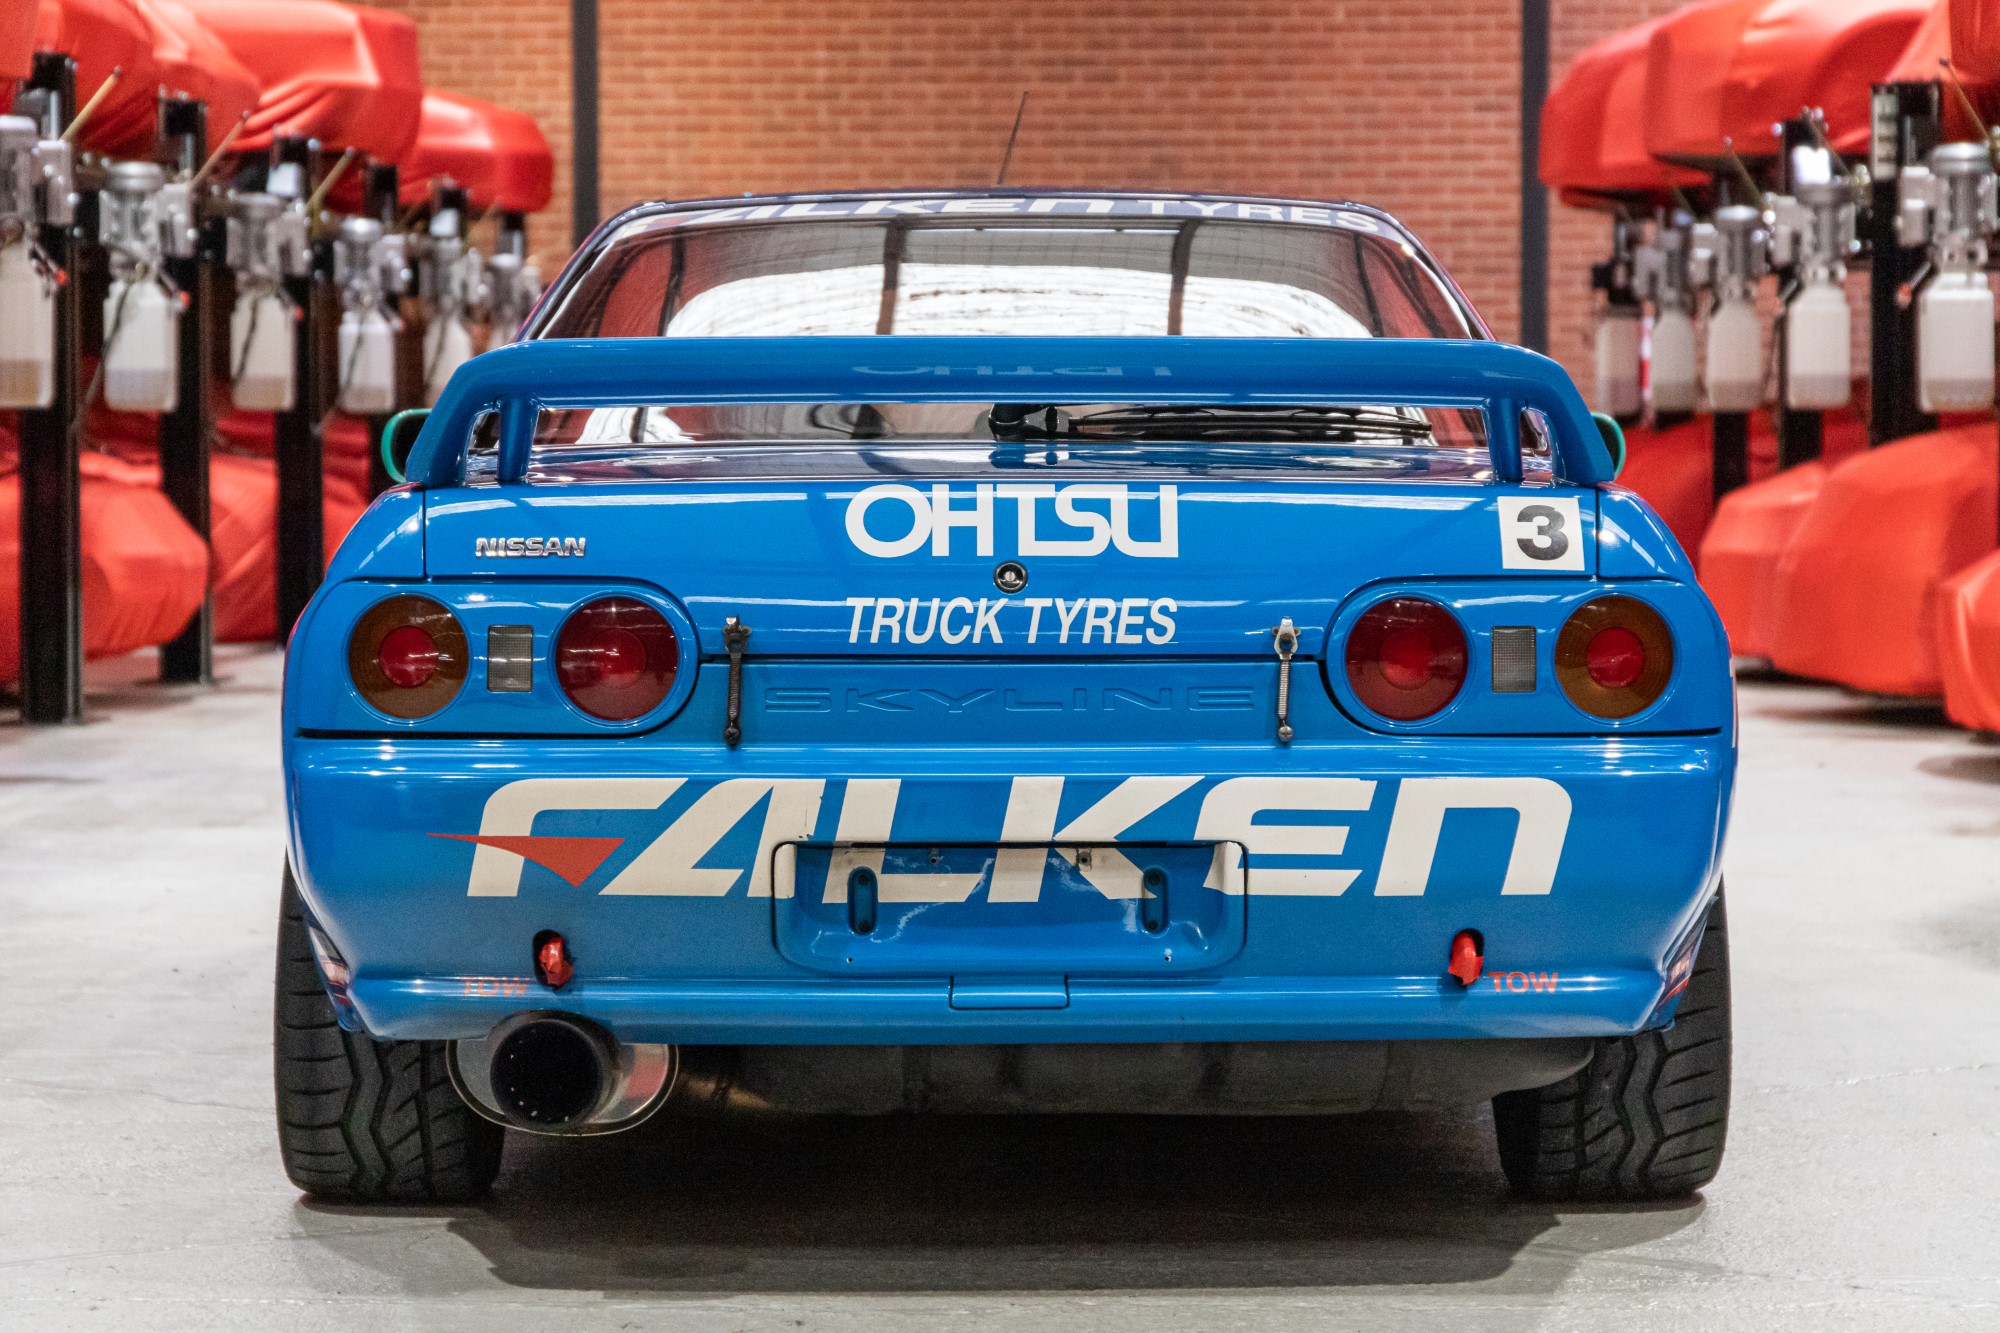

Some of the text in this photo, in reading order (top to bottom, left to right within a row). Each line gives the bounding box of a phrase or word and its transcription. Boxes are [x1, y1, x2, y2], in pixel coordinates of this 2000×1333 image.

[1137, 200, 1379, 232] TYRES
[845, 483, 1178, 559] OHTSU
[1516, 504, 1567, 561] 3
[474, 536, 586, 558] NISSAN
[846, 596, 1178, 645] TRUCK TYRES
[763, 687, 1256, 713] SKYLINE
[467, 776, 1573, 903] FALKEN
[460, 976, 529, 997] TOW
[1489, 971, 1559, 994] TOW
